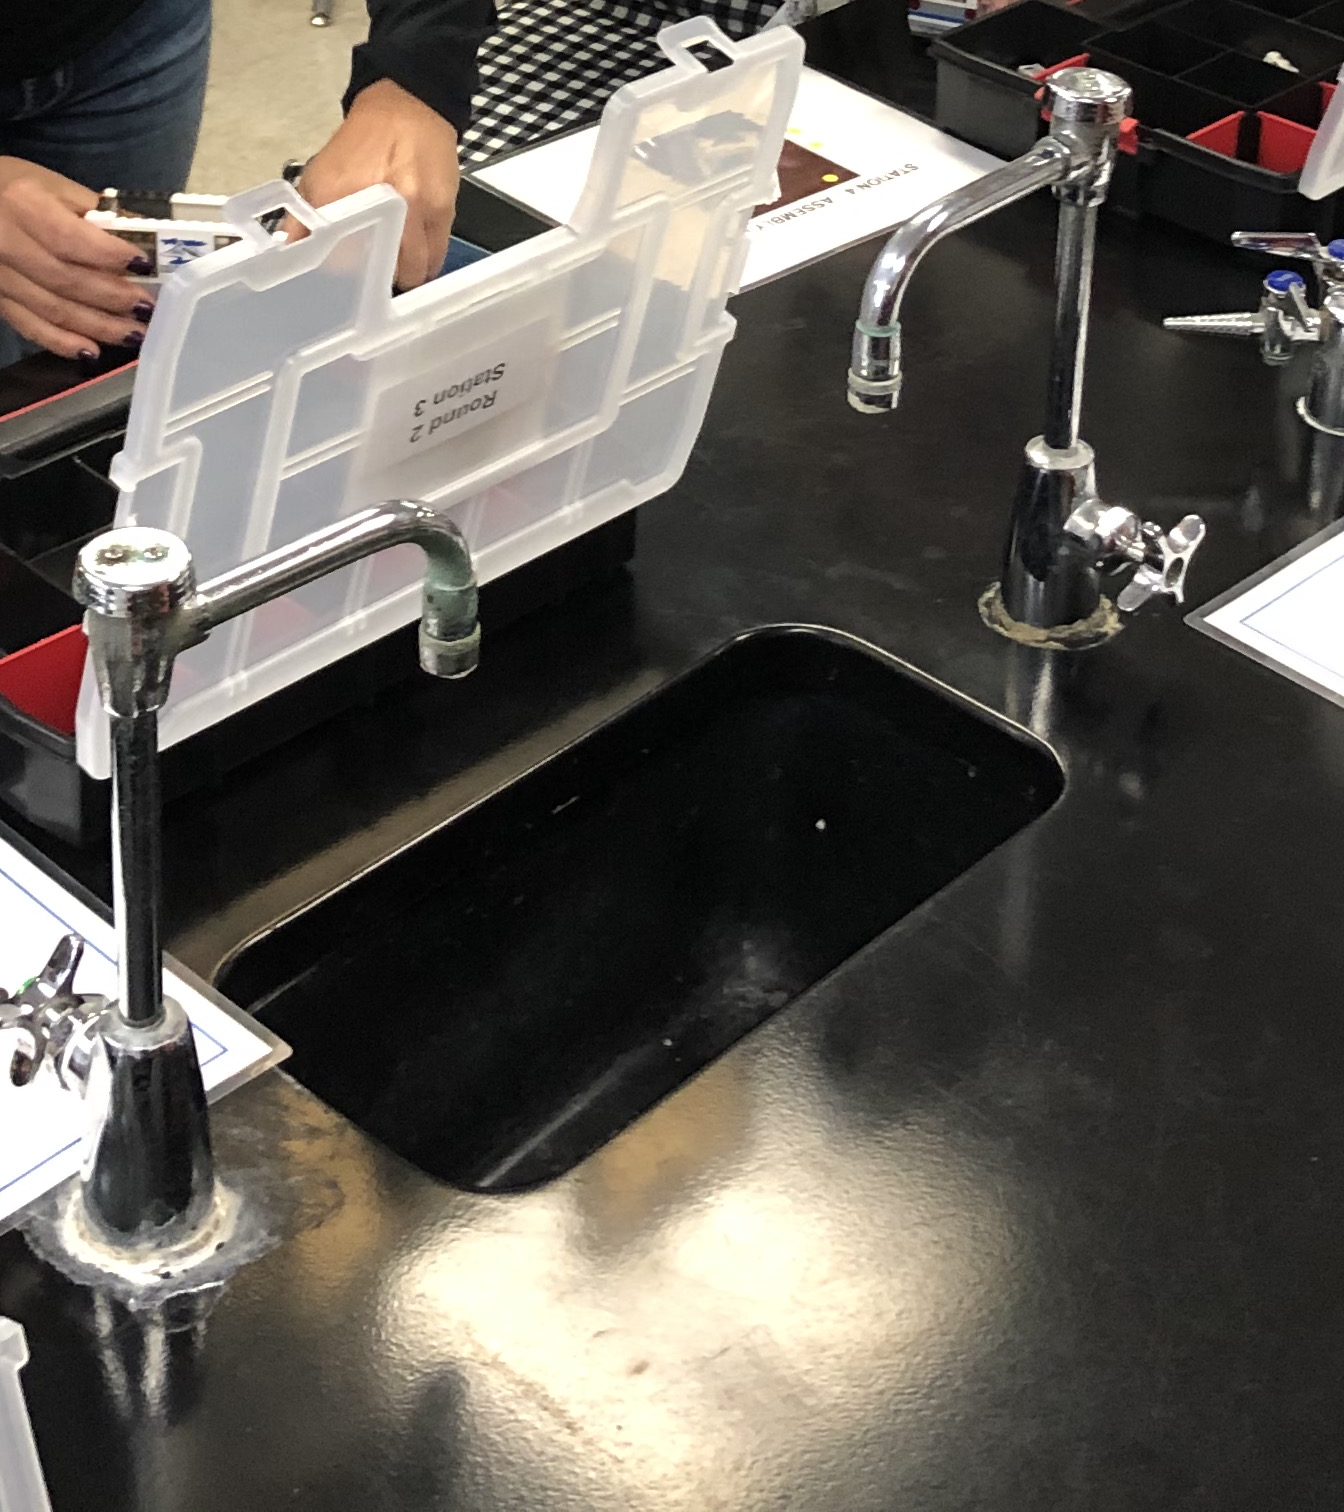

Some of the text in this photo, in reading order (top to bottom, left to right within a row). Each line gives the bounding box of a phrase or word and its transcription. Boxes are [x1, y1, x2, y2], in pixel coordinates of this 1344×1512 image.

[844, 187, 856, 196] 4
[855, 163, 919, 191] STATION
[413, 362, 506, 418] Station 3
[409, 389, 499, 443] Round 2
